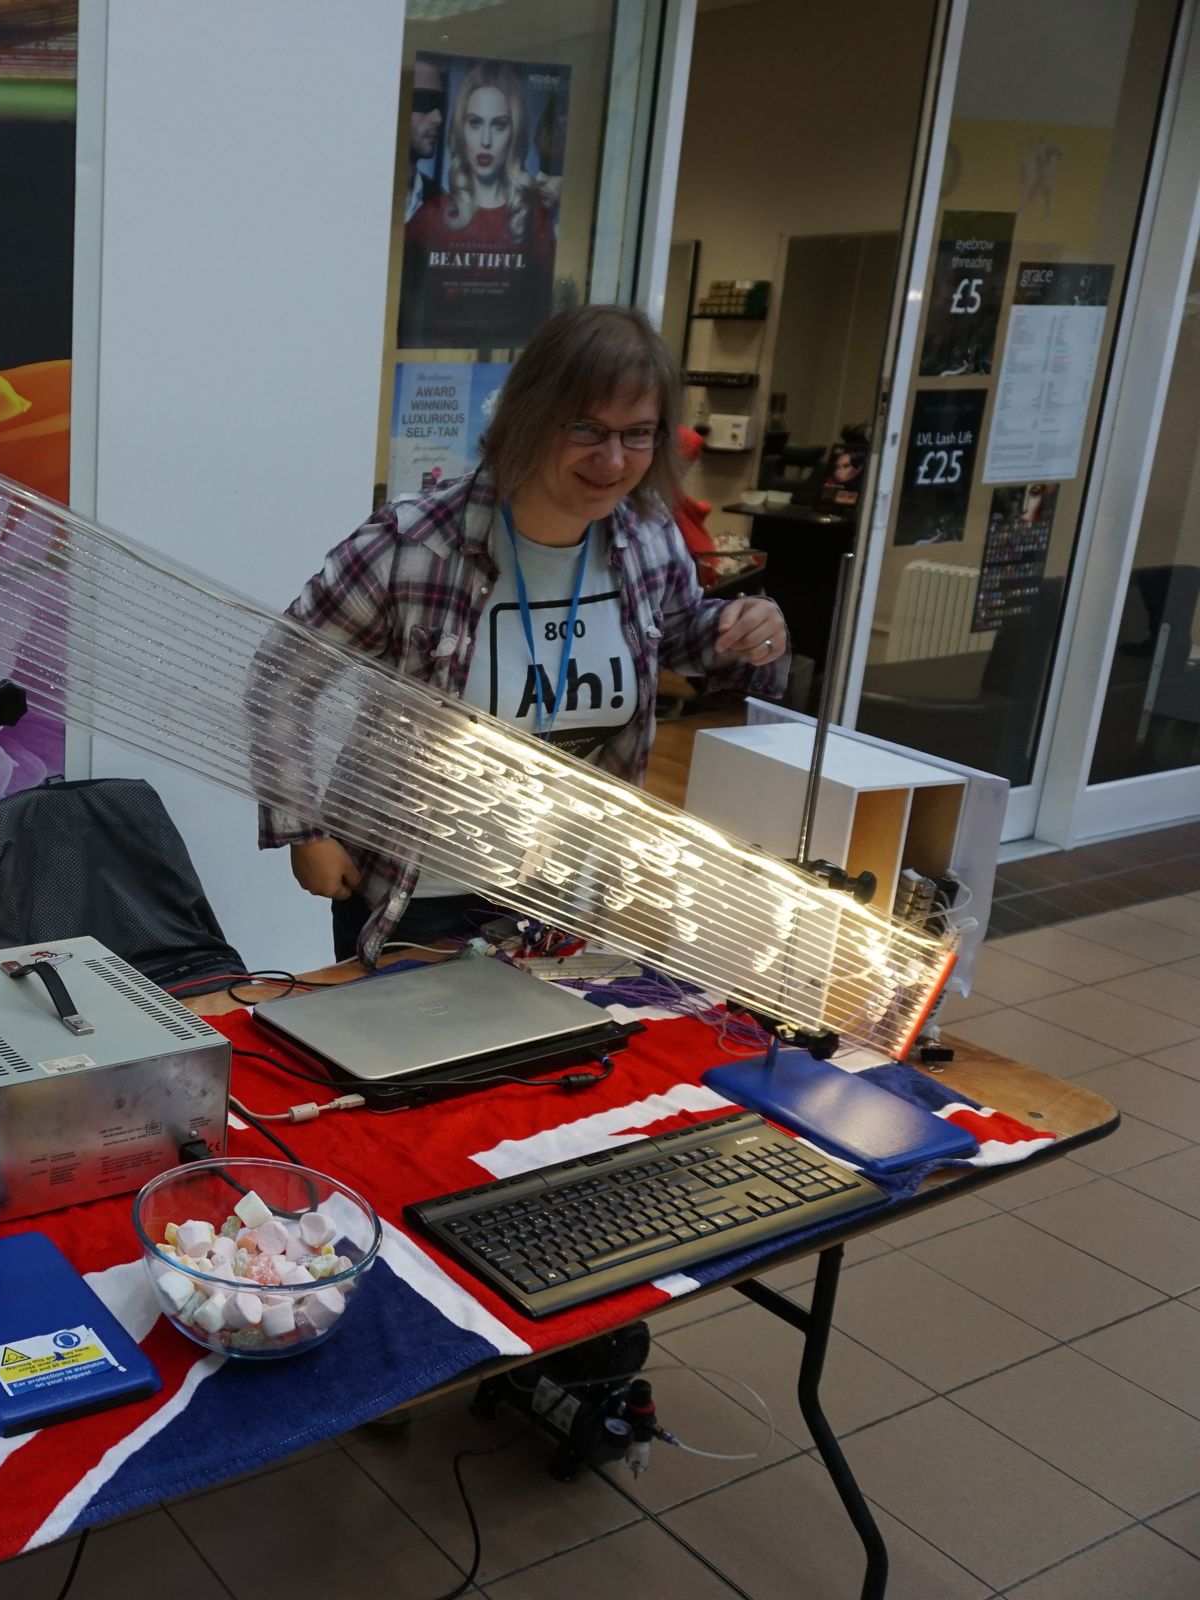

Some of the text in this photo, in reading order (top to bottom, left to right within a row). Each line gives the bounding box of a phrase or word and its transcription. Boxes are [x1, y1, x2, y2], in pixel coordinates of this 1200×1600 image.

[955, 236, 994, 252] eyebrow
[429, 251, 526, 268] BEAUTIFUL
[952, 255, 992, 272] threading
[1020, 267, 1054, 288] grace
[950, 278, 983, 314] £5
[416, 386, 456, 397] AWARD
[411, 399, 459, 411] WINNING
[402, 413, 465, 425] LUXURIOUS
[406, 427, 459, 438] SELF-TAN
[916, 430, 973, 445] LVL Lash Lift
[916, 449, 963, 485] £25
[544, 619, 586, 641] 800
[516, 656, 624, 718] Ah!
[5, 1361, 32, 1371] Warning
[13, 1380, 26, 1388] Ear
[27, 1371, 65, 1385] protection
[74, 1360, 106, 1373] available
[46, 1377, 63, 1386] your
[64, 1370, 92, 1381] request
